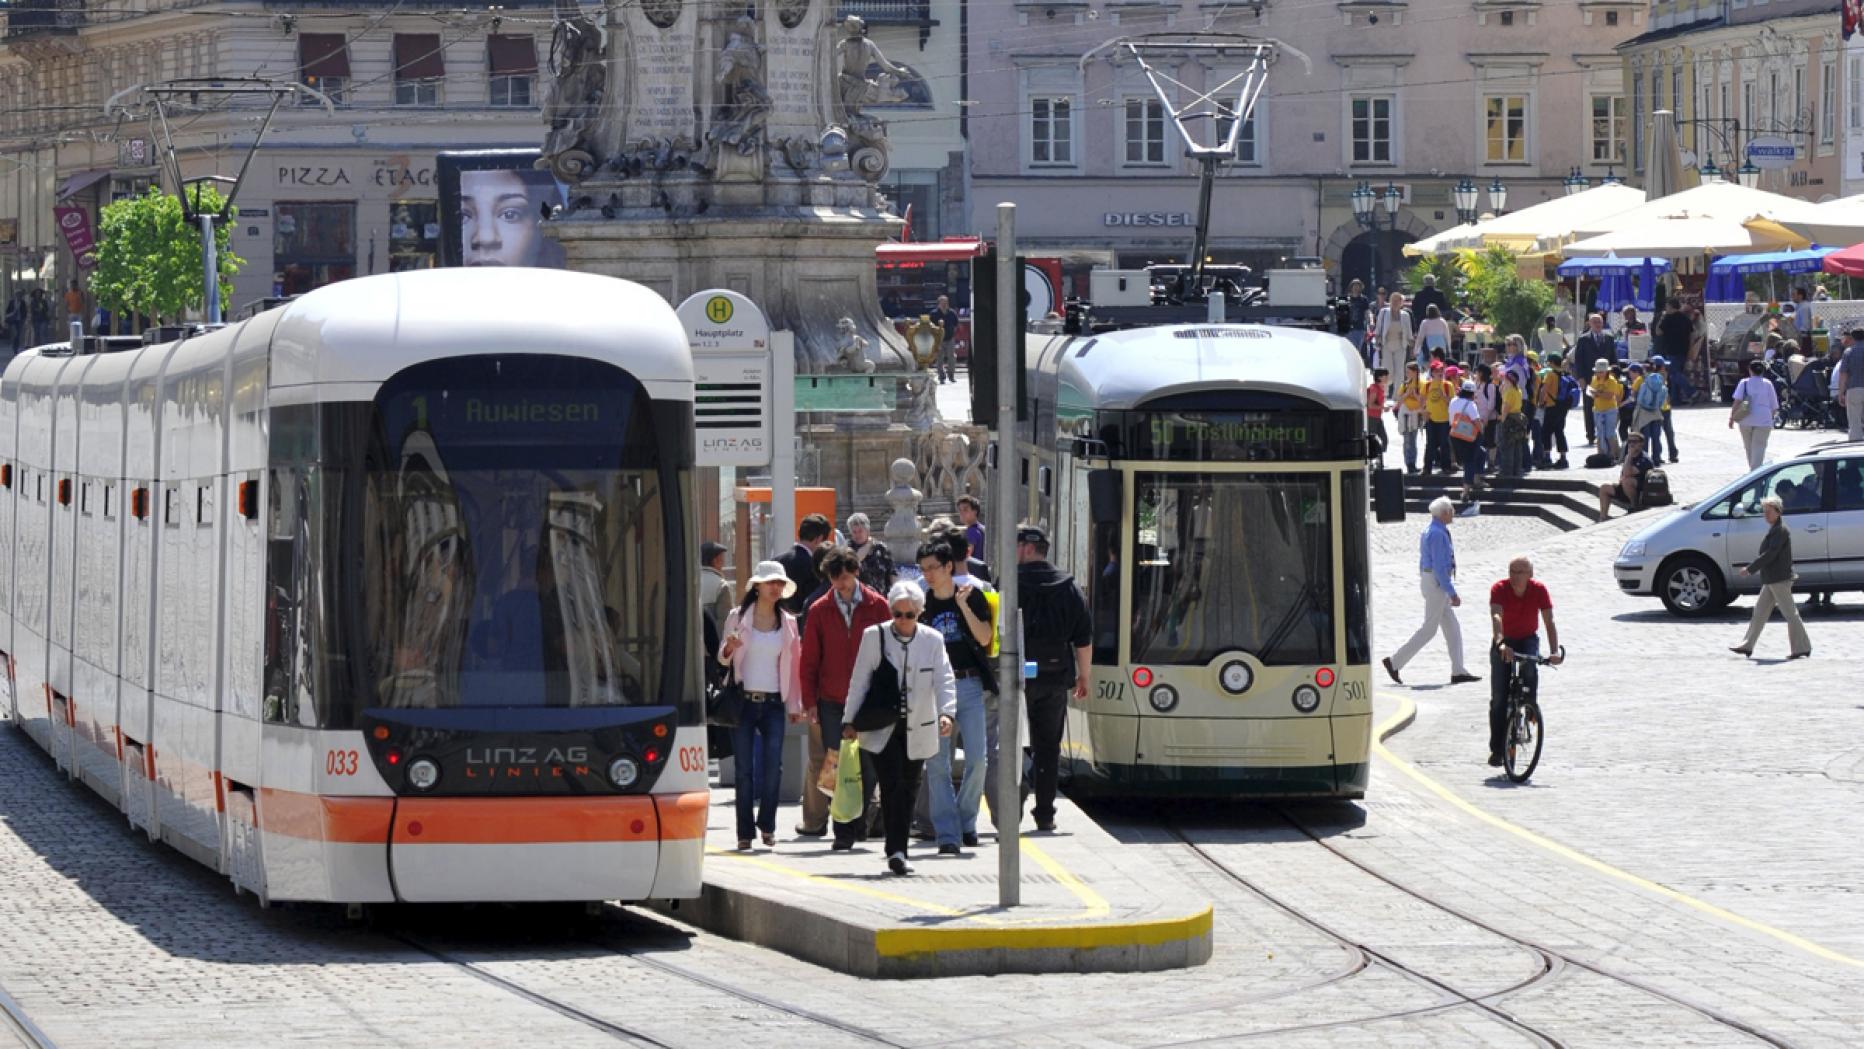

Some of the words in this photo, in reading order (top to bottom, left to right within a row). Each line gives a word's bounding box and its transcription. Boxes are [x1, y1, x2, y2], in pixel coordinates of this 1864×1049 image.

[278, 167, 350, 185] PIZZA
[1104, 212, 1197, 227] DIESEL
[695, 329, 744, 338] Hauptplatz
[412, 396, 427, 428] 1
[466, 399, 599, 422] Auwiesen
[741, 438, 762, 447] AG
[1096, 681, 1126, 699] 501
[1343, 681, 1368, 700] 501
[326, 750, 358, 775] 033
[466, 748, 537, 763] LINZ
[545, 746, 588, 762] AG
[679, 746, 704, 772] 033
[466, 765, 589, 777] LINIEN
